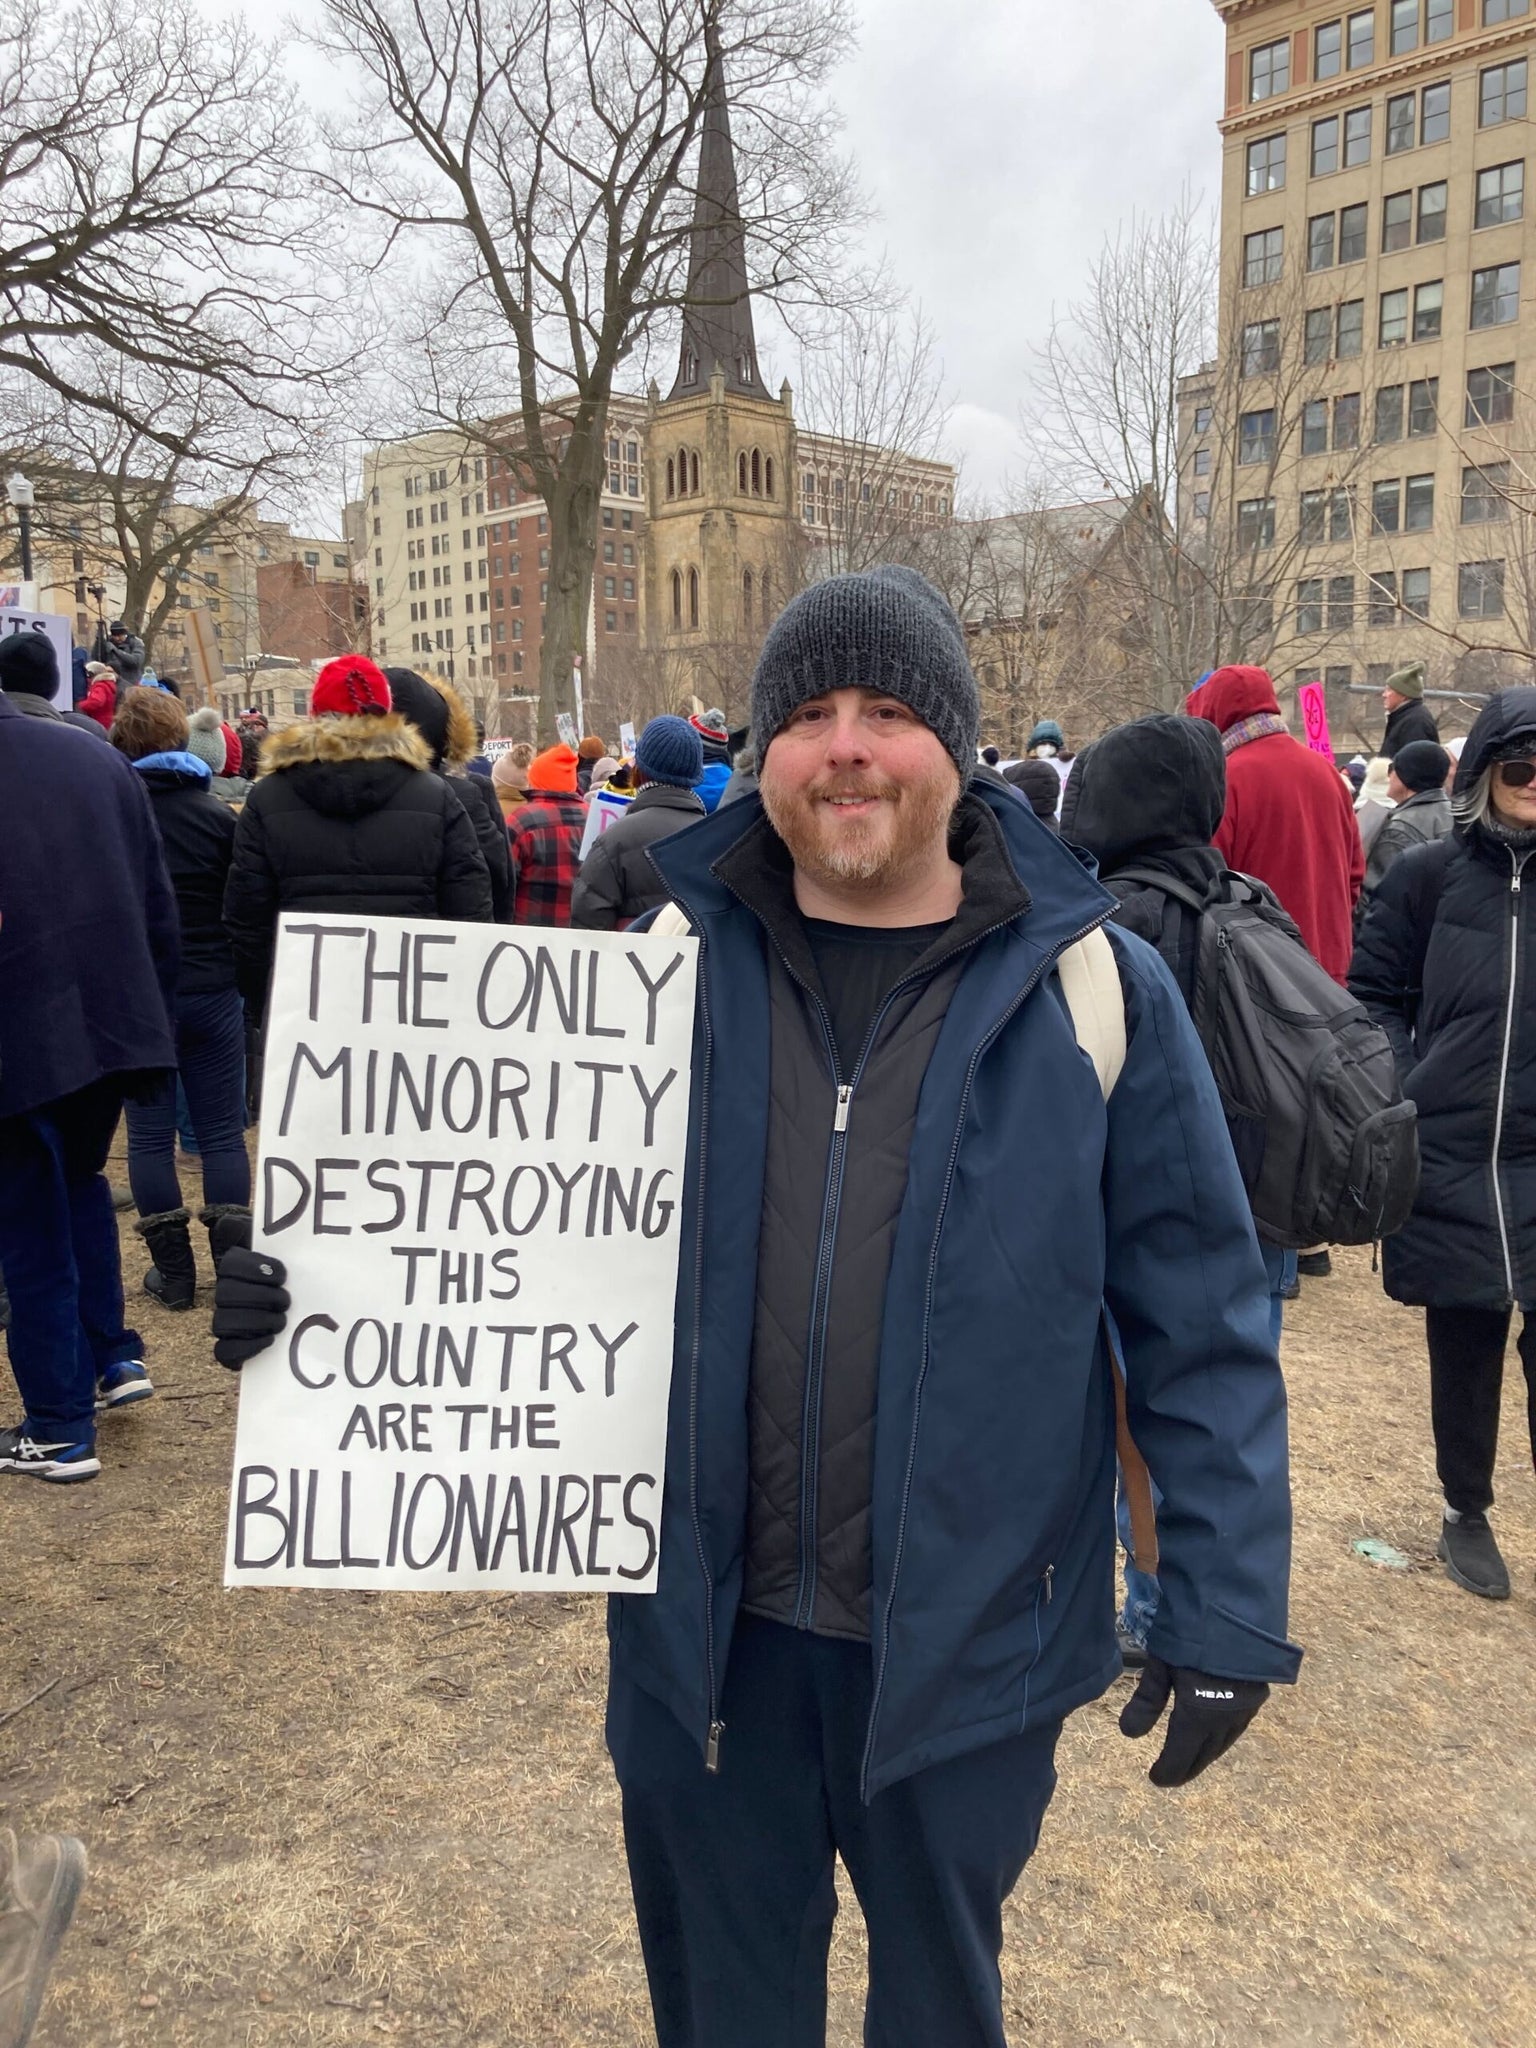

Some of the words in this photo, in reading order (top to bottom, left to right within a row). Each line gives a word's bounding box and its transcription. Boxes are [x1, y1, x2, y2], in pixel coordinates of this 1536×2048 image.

[285, 924, 456, 1028] THE
[477, 941, 684, 1045] ONLY
[279, 1042, 678, 1147] MINORITY
[262, 1157, 675, 1239] DESTROYING
[391, 1247, 520, 1305] THIS
[289, 1314, 640, 1397] COUNTRY
[338, 1403, 433, 1453] ARE
[445, 1404, 561, 1451] THE
[235, 1465, 658, 1580] BILLIONAIRES
[1195, 1689, 1234, 1699] HEAD
